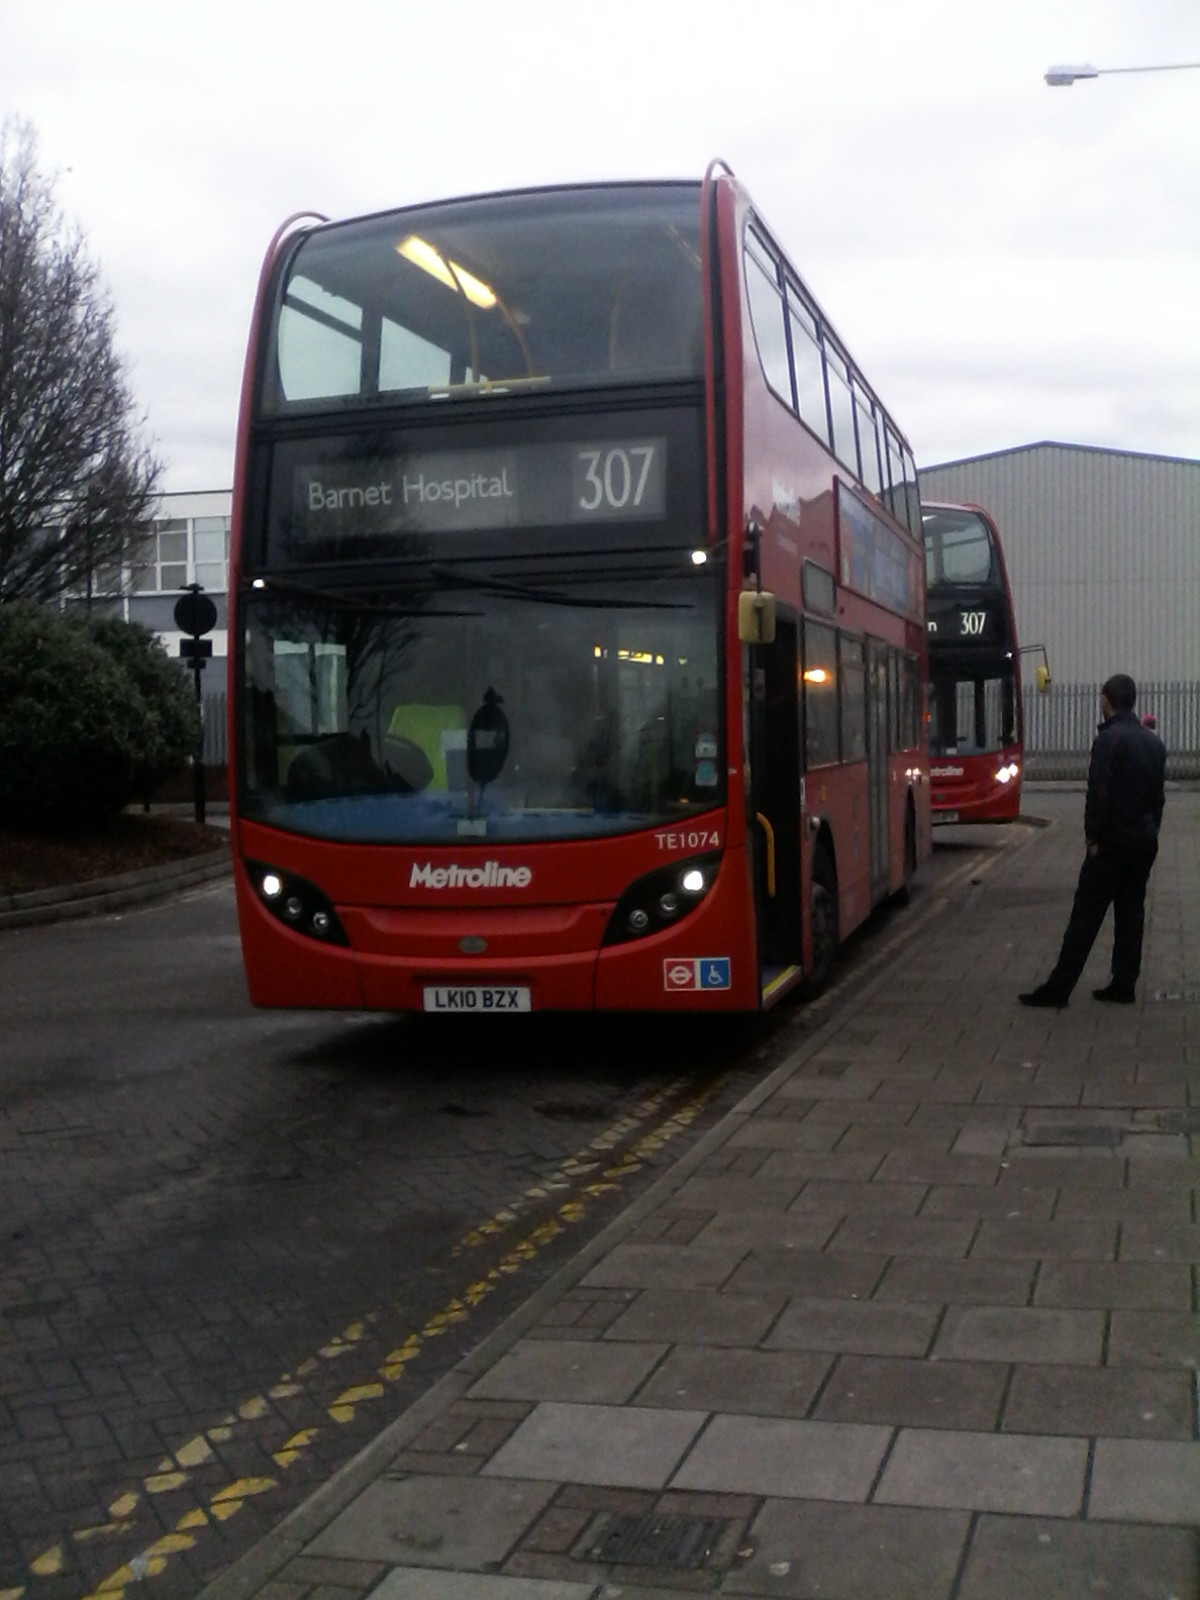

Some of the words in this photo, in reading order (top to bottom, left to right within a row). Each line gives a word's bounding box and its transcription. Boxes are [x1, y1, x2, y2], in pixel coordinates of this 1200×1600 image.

[308, 481, 392, 511] Barnet
[402, 467, 513, 508] Hospital
[578, 446, 656, 510] 307
[960, 612, 986, 635] 307
[654, 831, 720, 849] TE1074
[408, 861, 533, 889] Metroline
[435, 990, 477, 1009] LK10
[482, 990, 519, 1009] BZX
